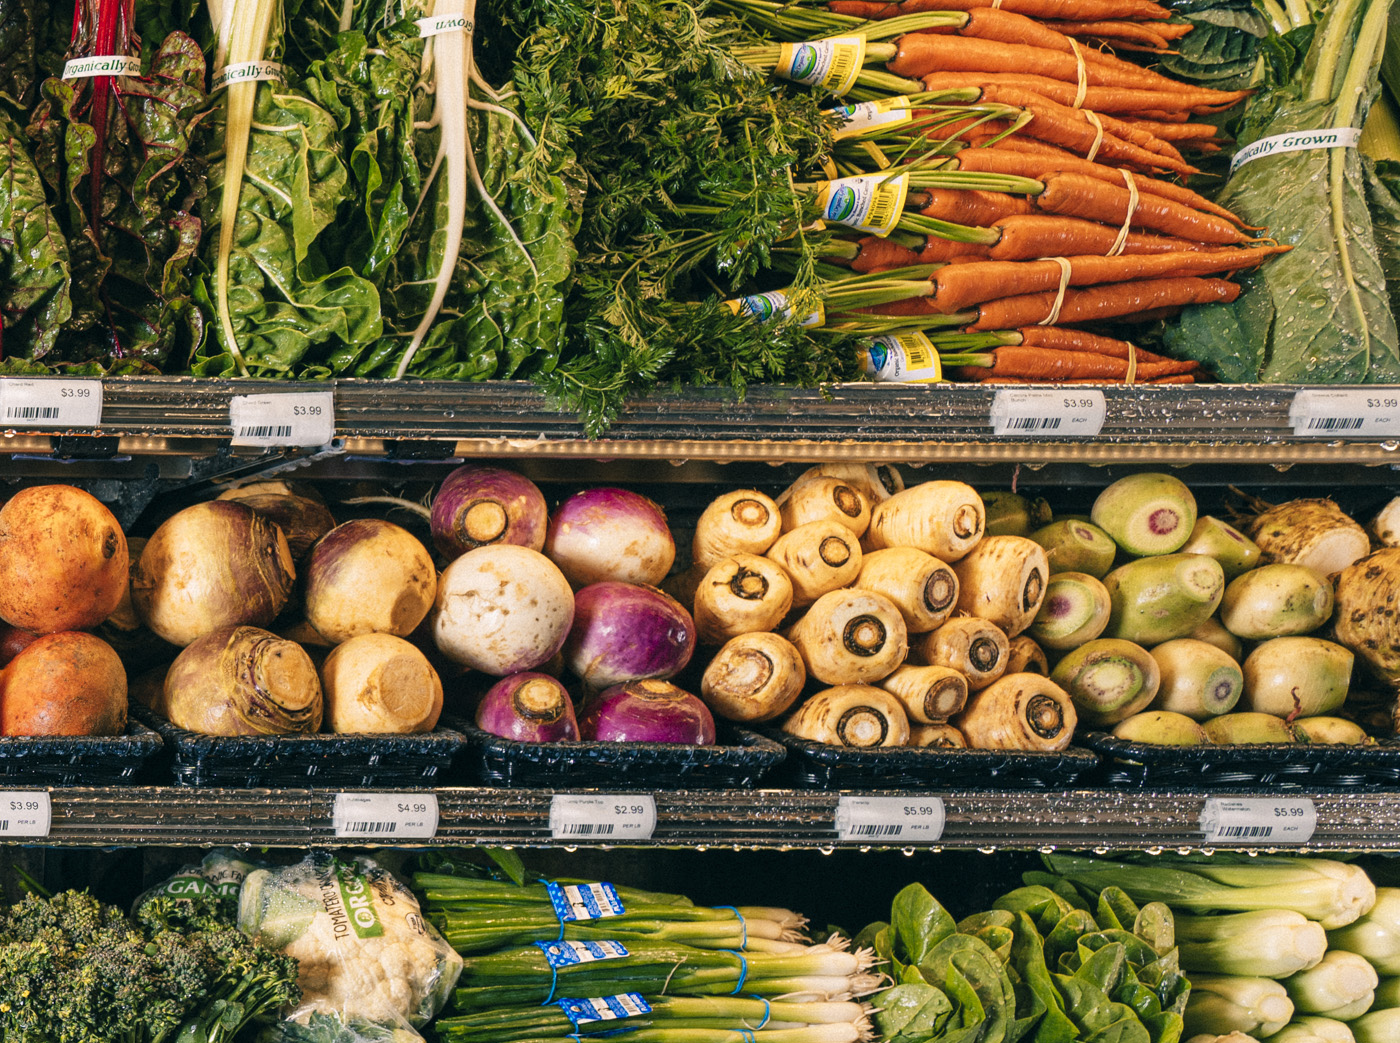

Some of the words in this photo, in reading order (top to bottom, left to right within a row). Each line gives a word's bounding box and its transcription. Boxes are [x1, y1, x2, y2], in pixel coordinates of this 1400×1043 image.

[1283, 134, 1337, 147] Grown
[61, 388, 90, 397] $3.99
[1063, 399, 1093, 407] $3.99
[1367, 399, 1397, 407] $3.99
[293, 406, 321, 415] $3.99
[10, 802, 38, 810] $3.99
[398, 804, 426, 812] $4.99
[615, 806, 643, 814] $2.99
[904, 807, 932, 815] $5.99
[1274, 808, 1304, 816] $5.99
